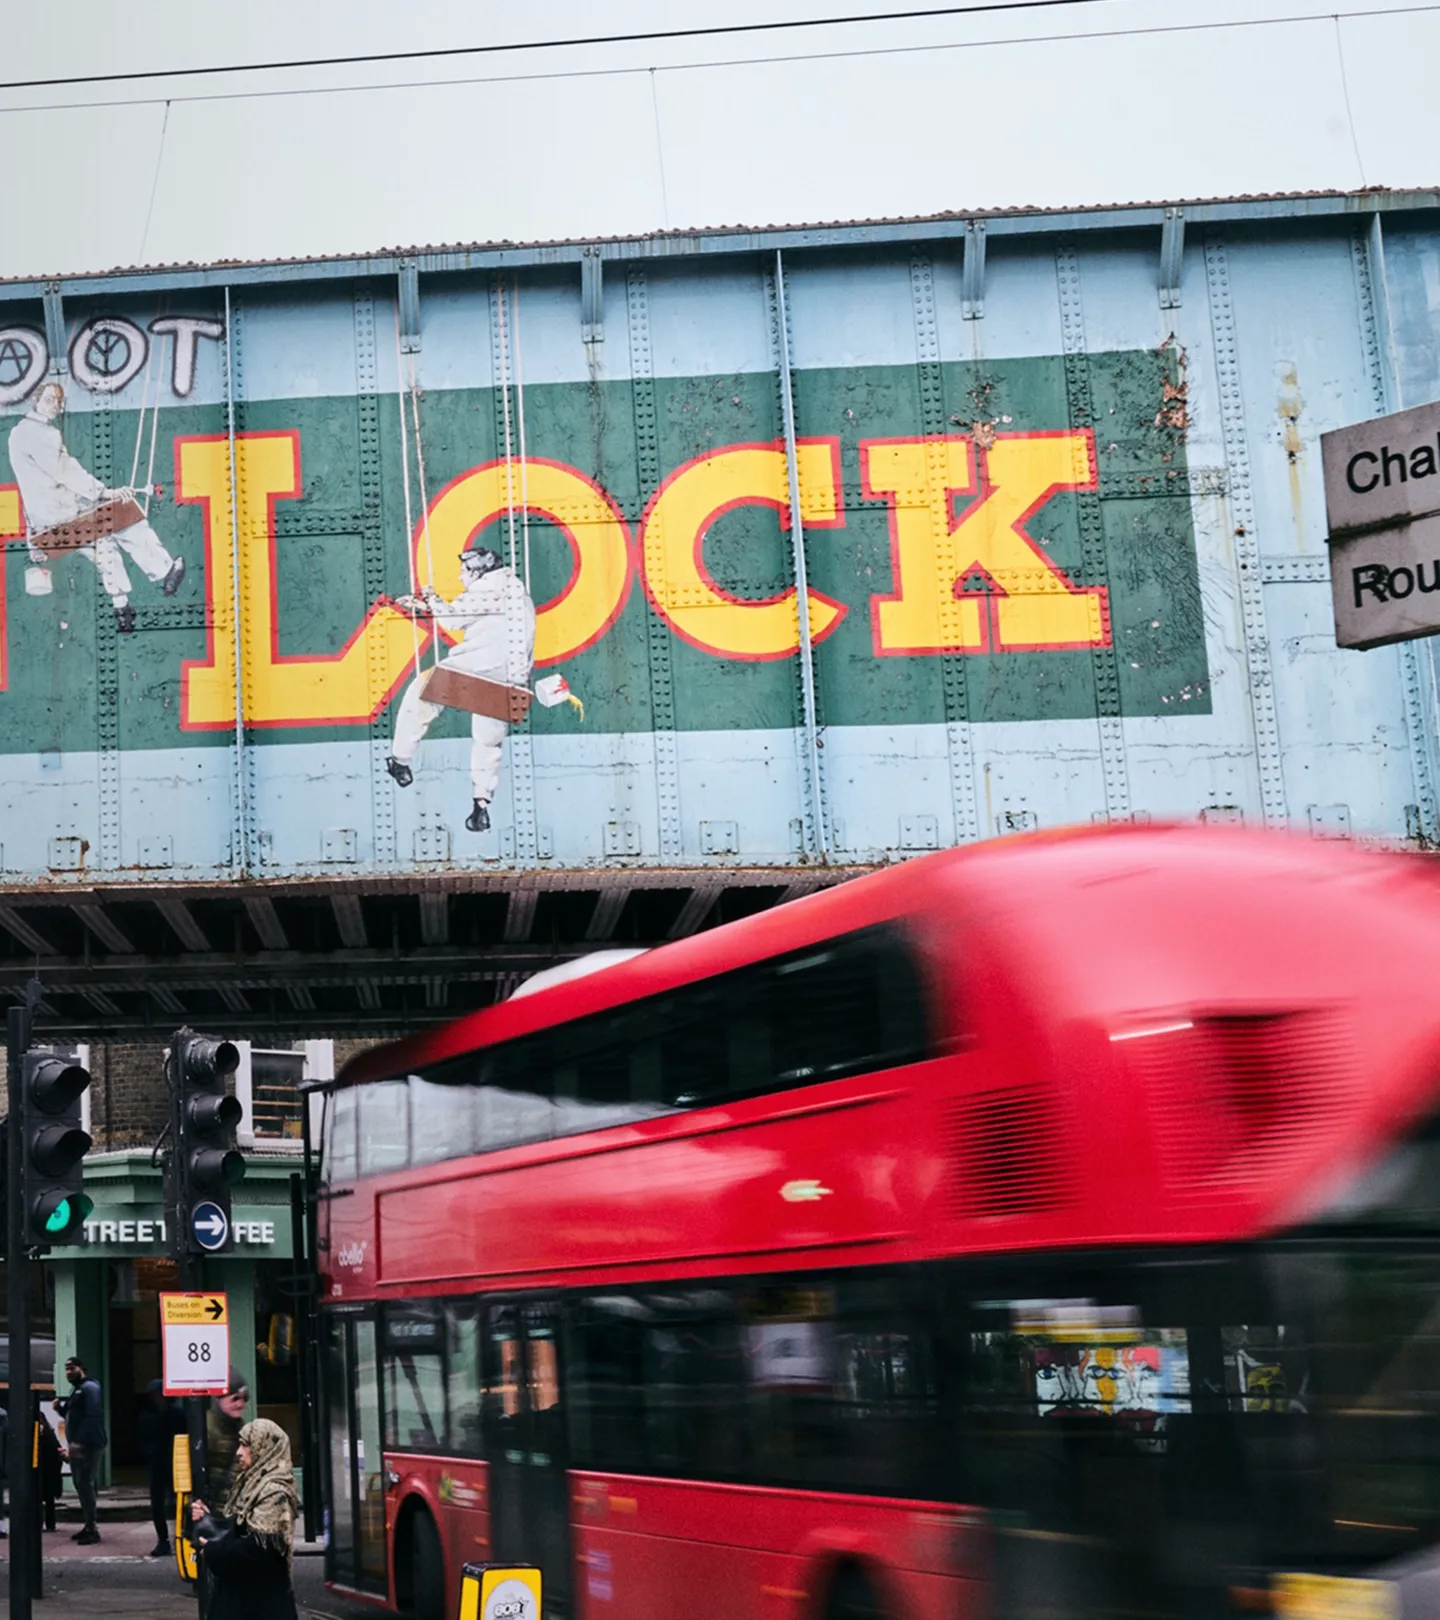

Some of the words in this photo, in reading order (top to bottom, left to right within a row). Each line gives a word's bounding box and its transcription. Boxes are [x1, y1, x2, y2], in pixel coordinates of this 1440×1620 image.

[173, 428, 1114, 732] LOCK
[83, 1219, 167, 1243] TREET
[167, 1301, 189, 1309] Buses
[167, 1311, 203, 1319] Diversion
[188, 1342, 211, 1362] 88
